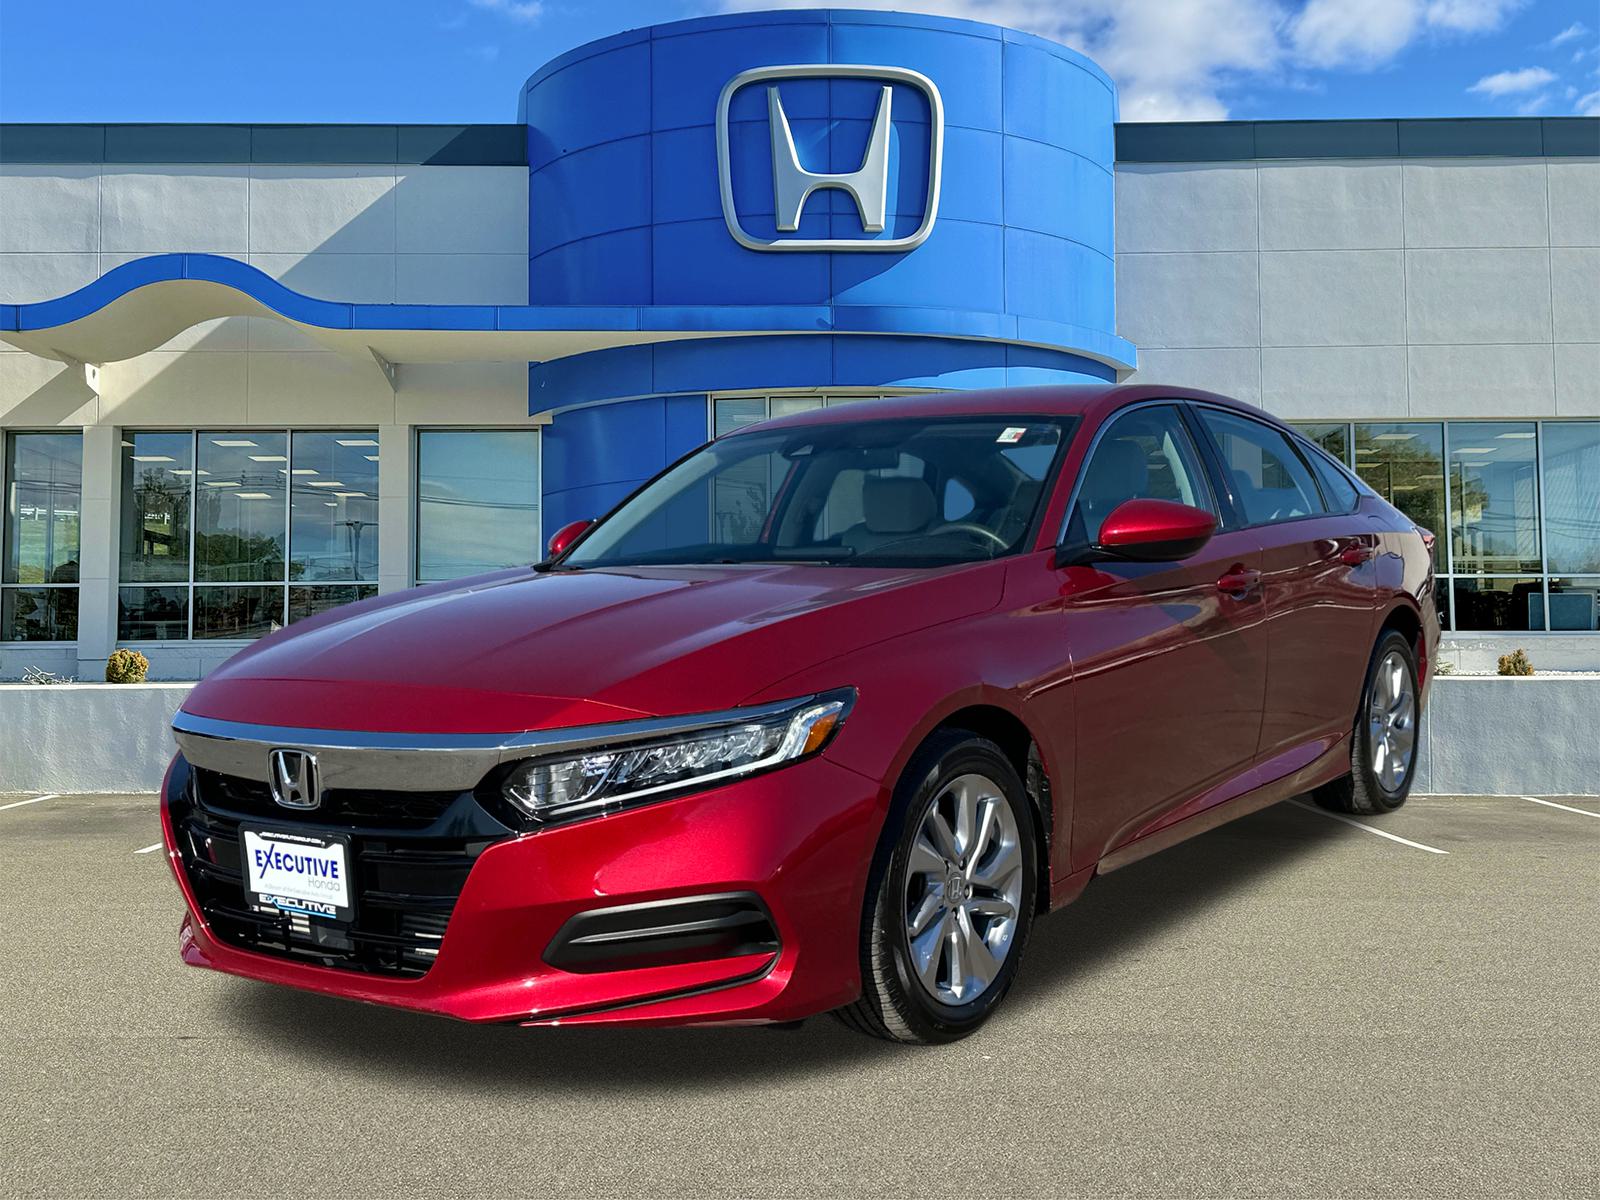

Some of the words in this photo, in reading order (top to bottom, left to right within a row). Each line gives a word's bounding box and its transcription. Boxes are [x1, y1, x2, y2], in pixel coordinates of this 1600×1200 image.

[255, 843, 339, 879] EXECUTIVE
[308, 878, 341, 892] Honda
[259, 893, 336, 915] EXECUTIVE
